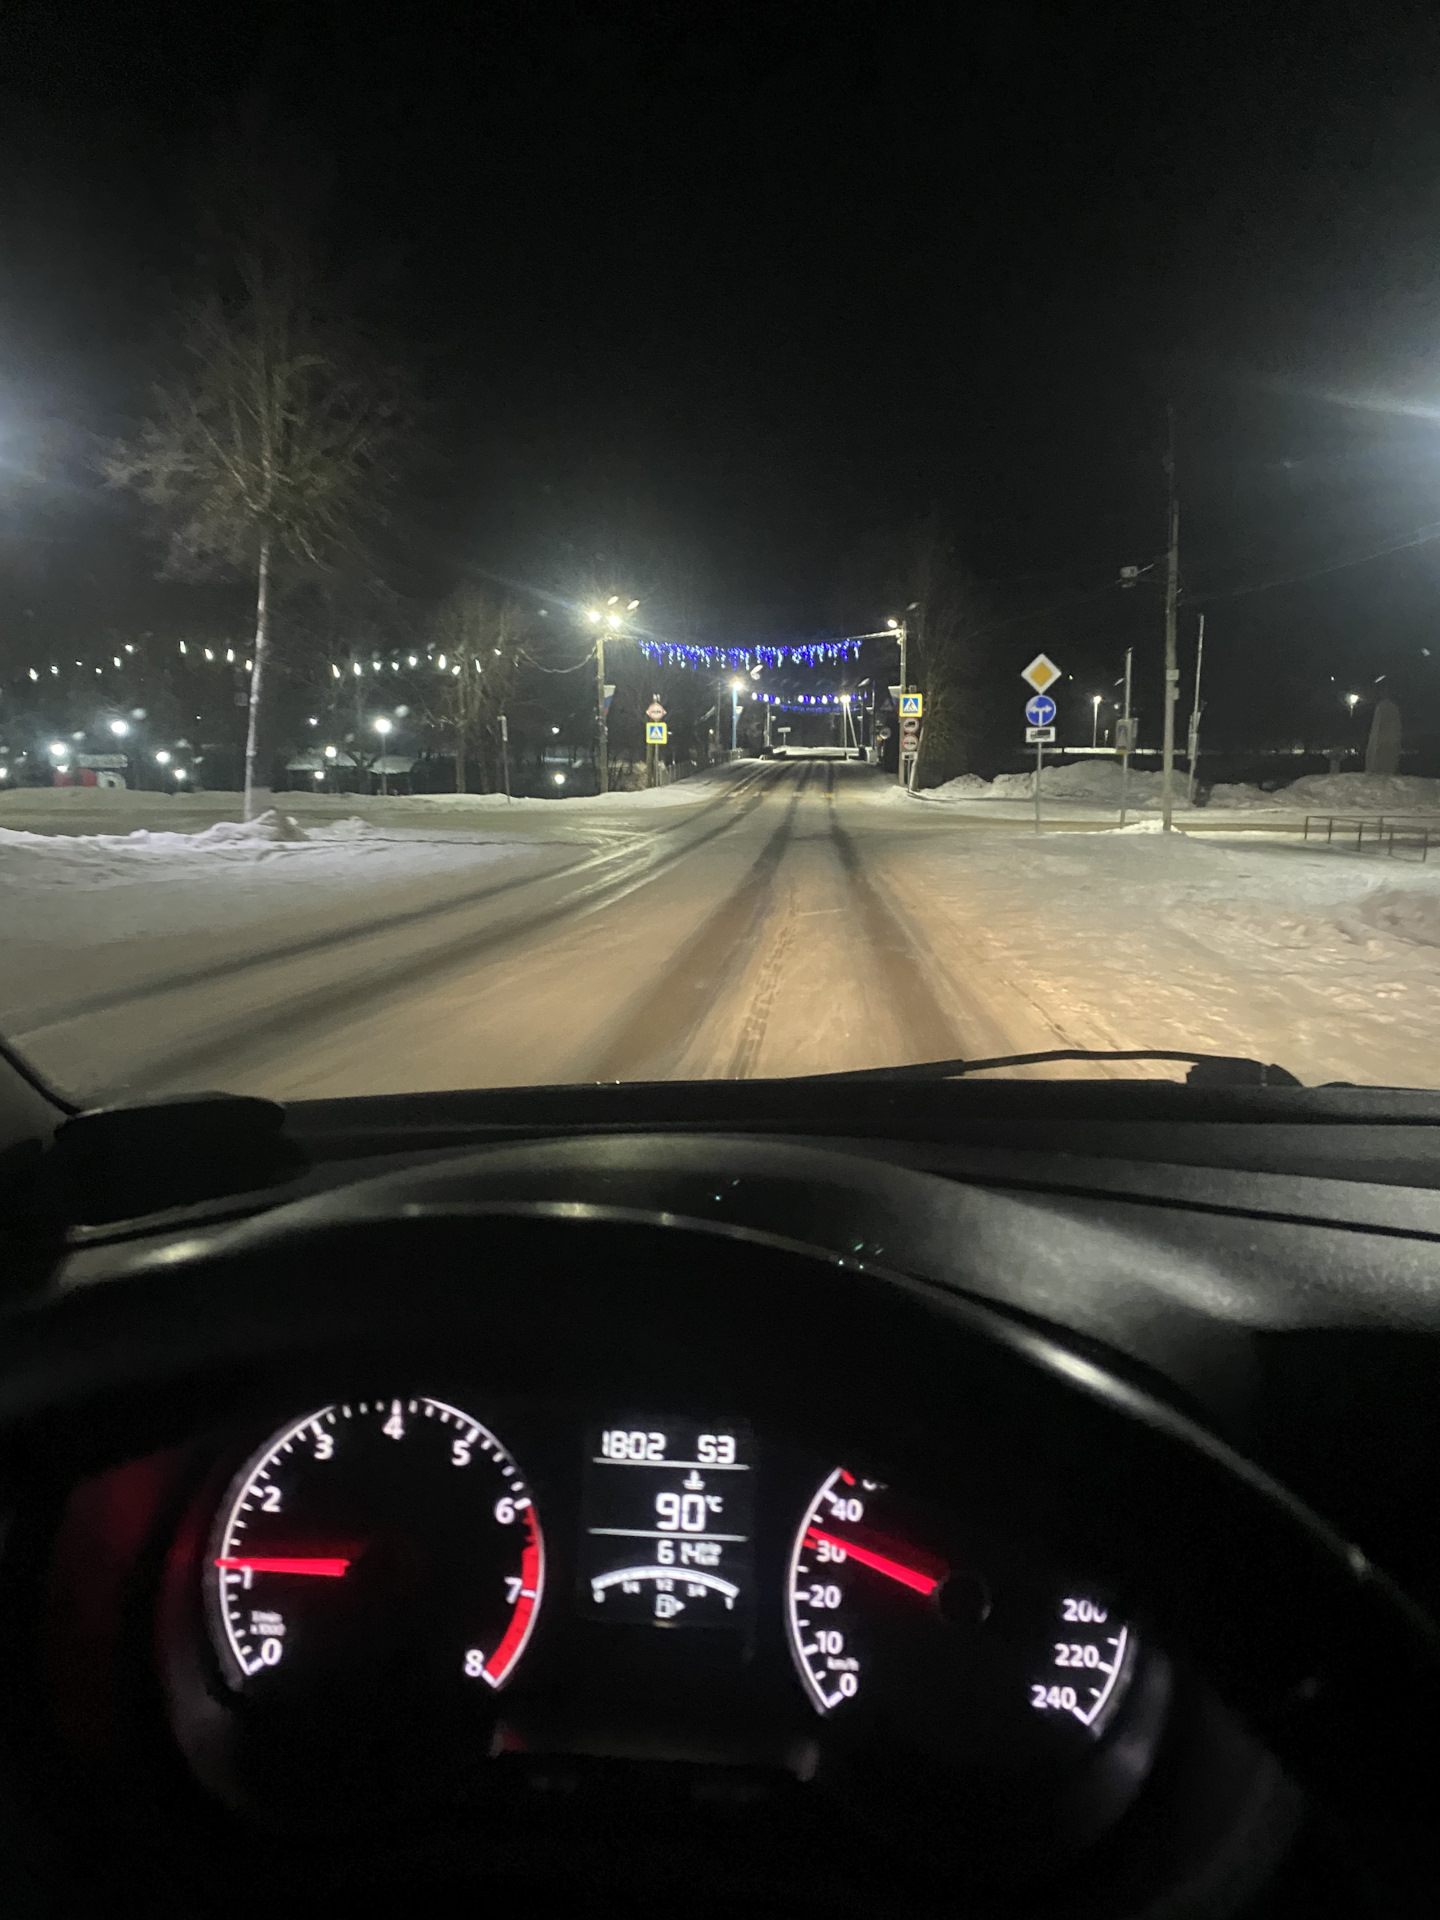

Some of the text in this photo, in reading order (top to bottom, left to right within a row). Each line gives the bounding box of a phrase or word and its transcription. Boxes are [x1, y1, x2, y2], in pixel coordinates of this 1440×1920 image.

[382, 1416, 405, 1440] 4
[314, 1434, 334, 1460] 3
[452, 1440, 472, 1467] 5
[262, 1486, 282, 1513] 2
[494, 1498, 515, 1525] 6
[830, 1496, 863, 1523] 40
[816, 1540, 847, 1565] 30
[504, 1577, 522, 1604] 7
[809, 1583, 842, 1610] 20
[261, 1638, 283, 1665] 0
[815, 1630, 843, 1655] 10
[1054, 1642, 1100, 1668] 220
[465, 1649, 485, 1677] 8
[839, 1672, 858, 1697] 0
[1030, 1683, 1077, 1710] 240
